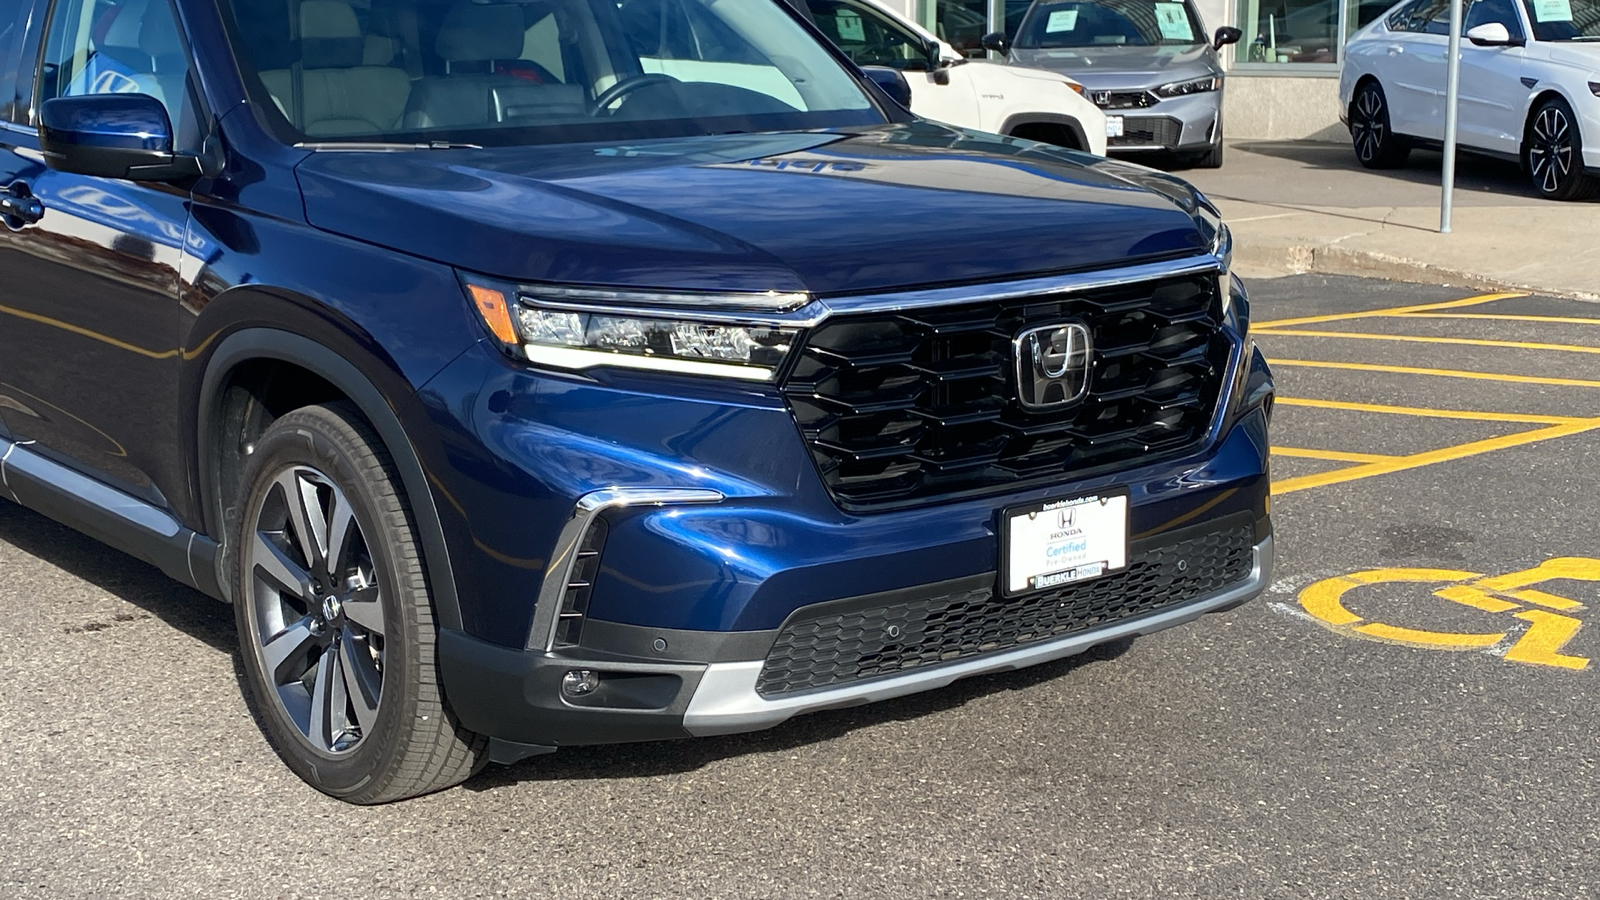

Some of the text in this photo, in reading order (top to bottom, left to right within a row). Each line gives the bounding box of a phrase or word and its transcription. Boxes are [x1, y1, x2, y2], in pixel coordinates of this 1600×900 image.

[1050, 528, 1082, 540] HONDA
[1046, 539, 1087, 557] Certified
[1046, 553, 1087, 566] Pre-Owned
